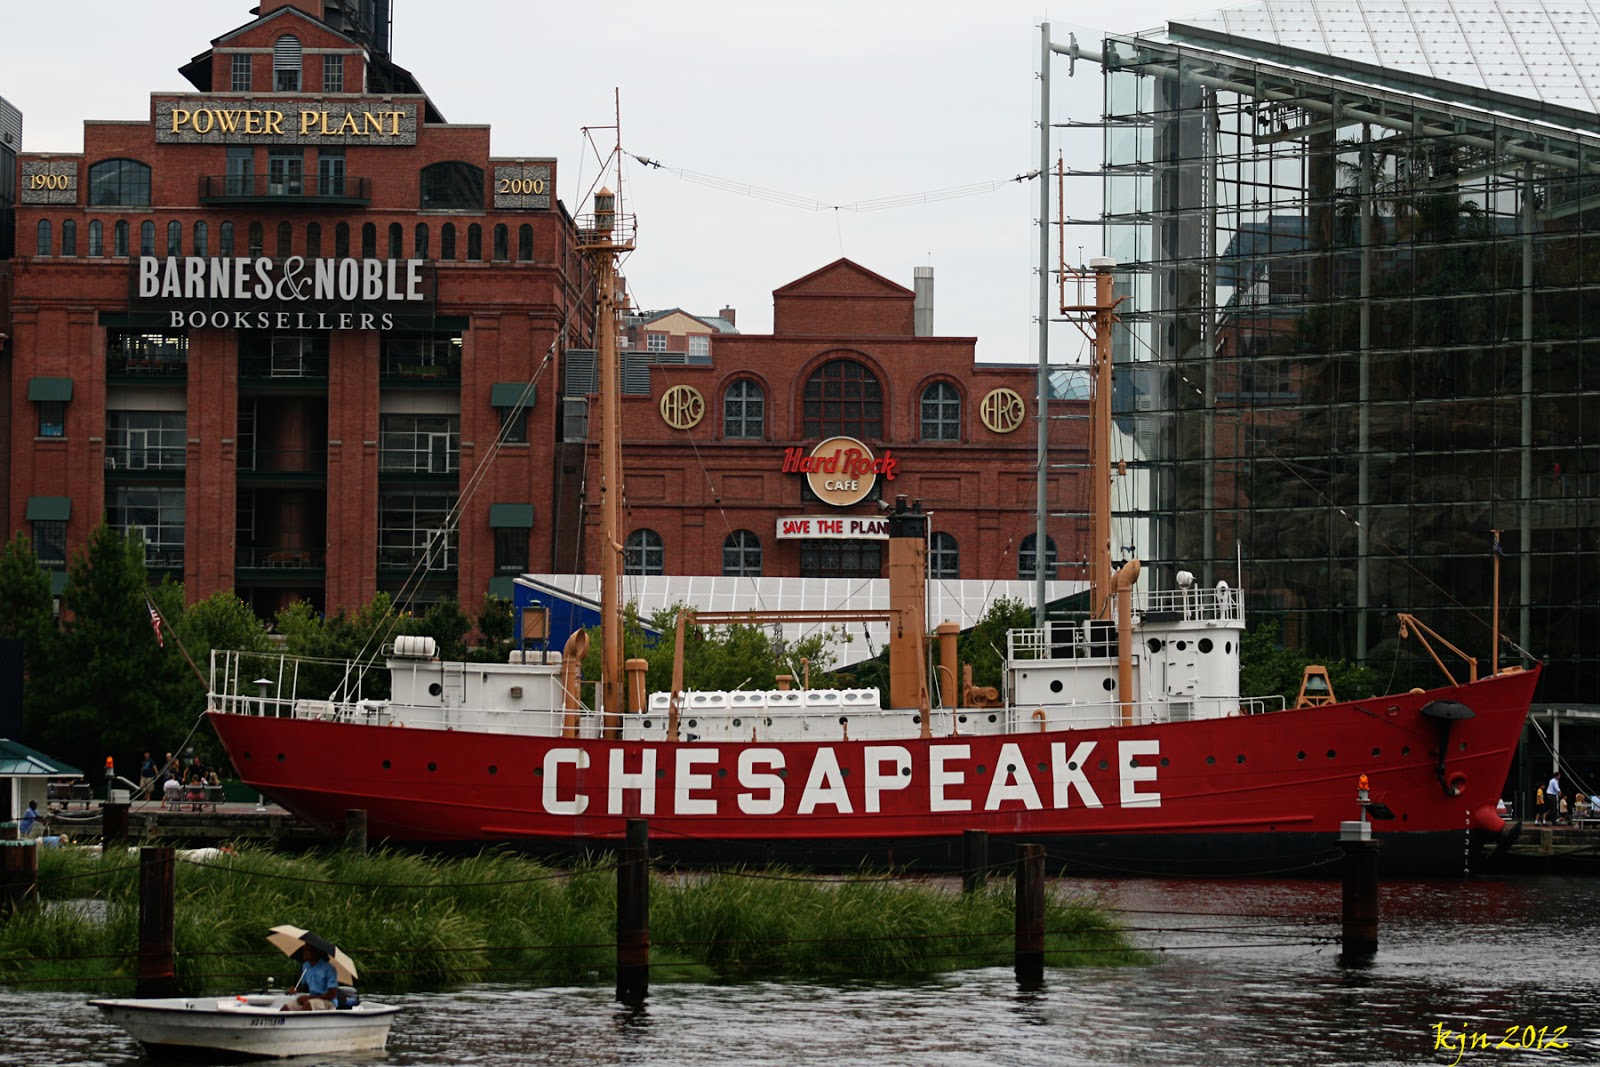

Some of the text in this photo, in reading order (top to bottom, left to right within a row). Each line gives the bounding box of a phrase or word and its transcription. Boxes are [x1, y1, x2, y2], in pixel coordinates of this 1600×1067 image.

[171, 109, 406, 136] POWER PLANT
[30, 174, 68, 190] 1900
[499, 178, 544, 195] 2000
[169, 310, 394, 331] BOOKSELLERS
[660, 385, 705, 430] HRC
[980, 388, 1025, 433] HRC
[782, 447, 896, 480] Hard Rock
[824, 480, 859, 491] CAFE
[783, 521, 890, 535] SAVE THE PLAN
[541, 739, 1162, 816] CHESAPEAKE
